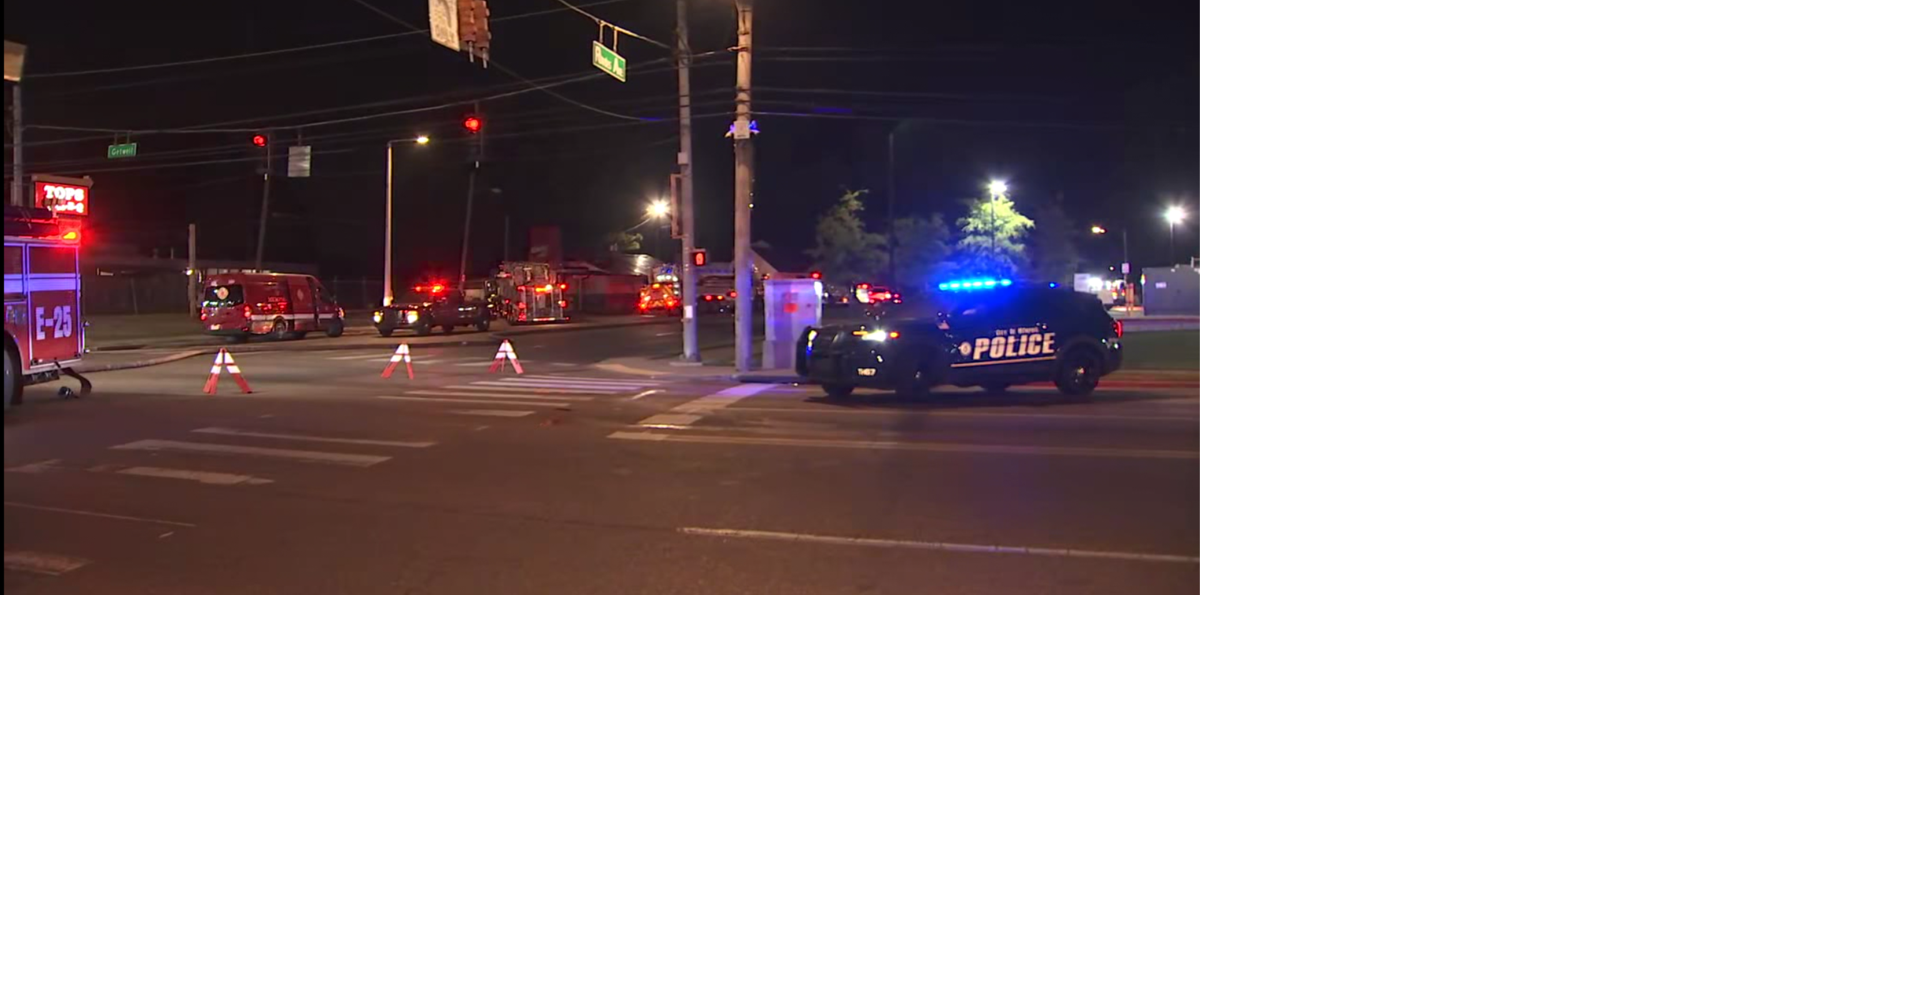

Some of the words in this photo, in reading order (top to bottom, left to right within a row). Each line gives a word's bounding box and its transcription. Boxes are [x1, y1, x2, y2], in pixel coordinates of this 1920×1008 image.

[44, 185, 84, 201] TOPS
[36, 305, 72, 340] E-25
[973, 332, 1055, 360] POLICE
